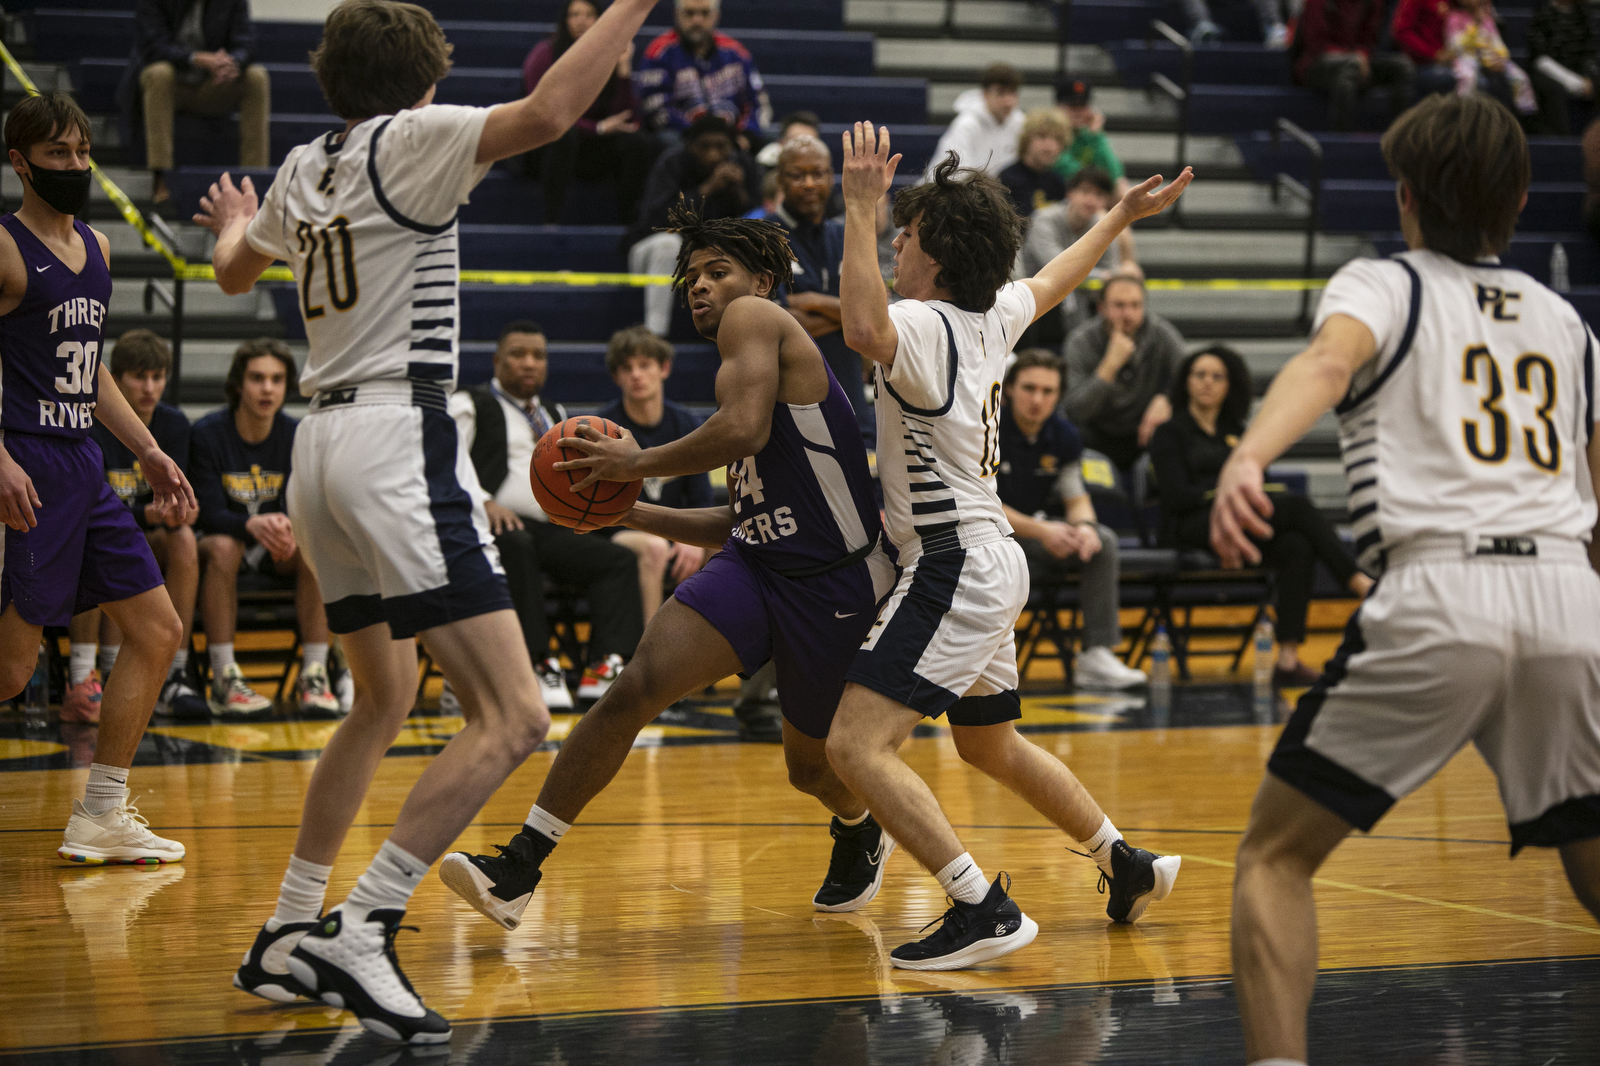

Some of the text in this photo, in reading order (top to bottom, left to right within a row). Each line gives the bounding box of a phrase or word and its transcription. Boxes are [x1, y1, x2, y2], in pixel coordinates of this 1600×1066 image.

[297, 214, 359, 321] 20
[1474, 283, 1522, 322] PC
[54, 341, 99, 395] 30
[1462, 343, 1562, 476] 33
